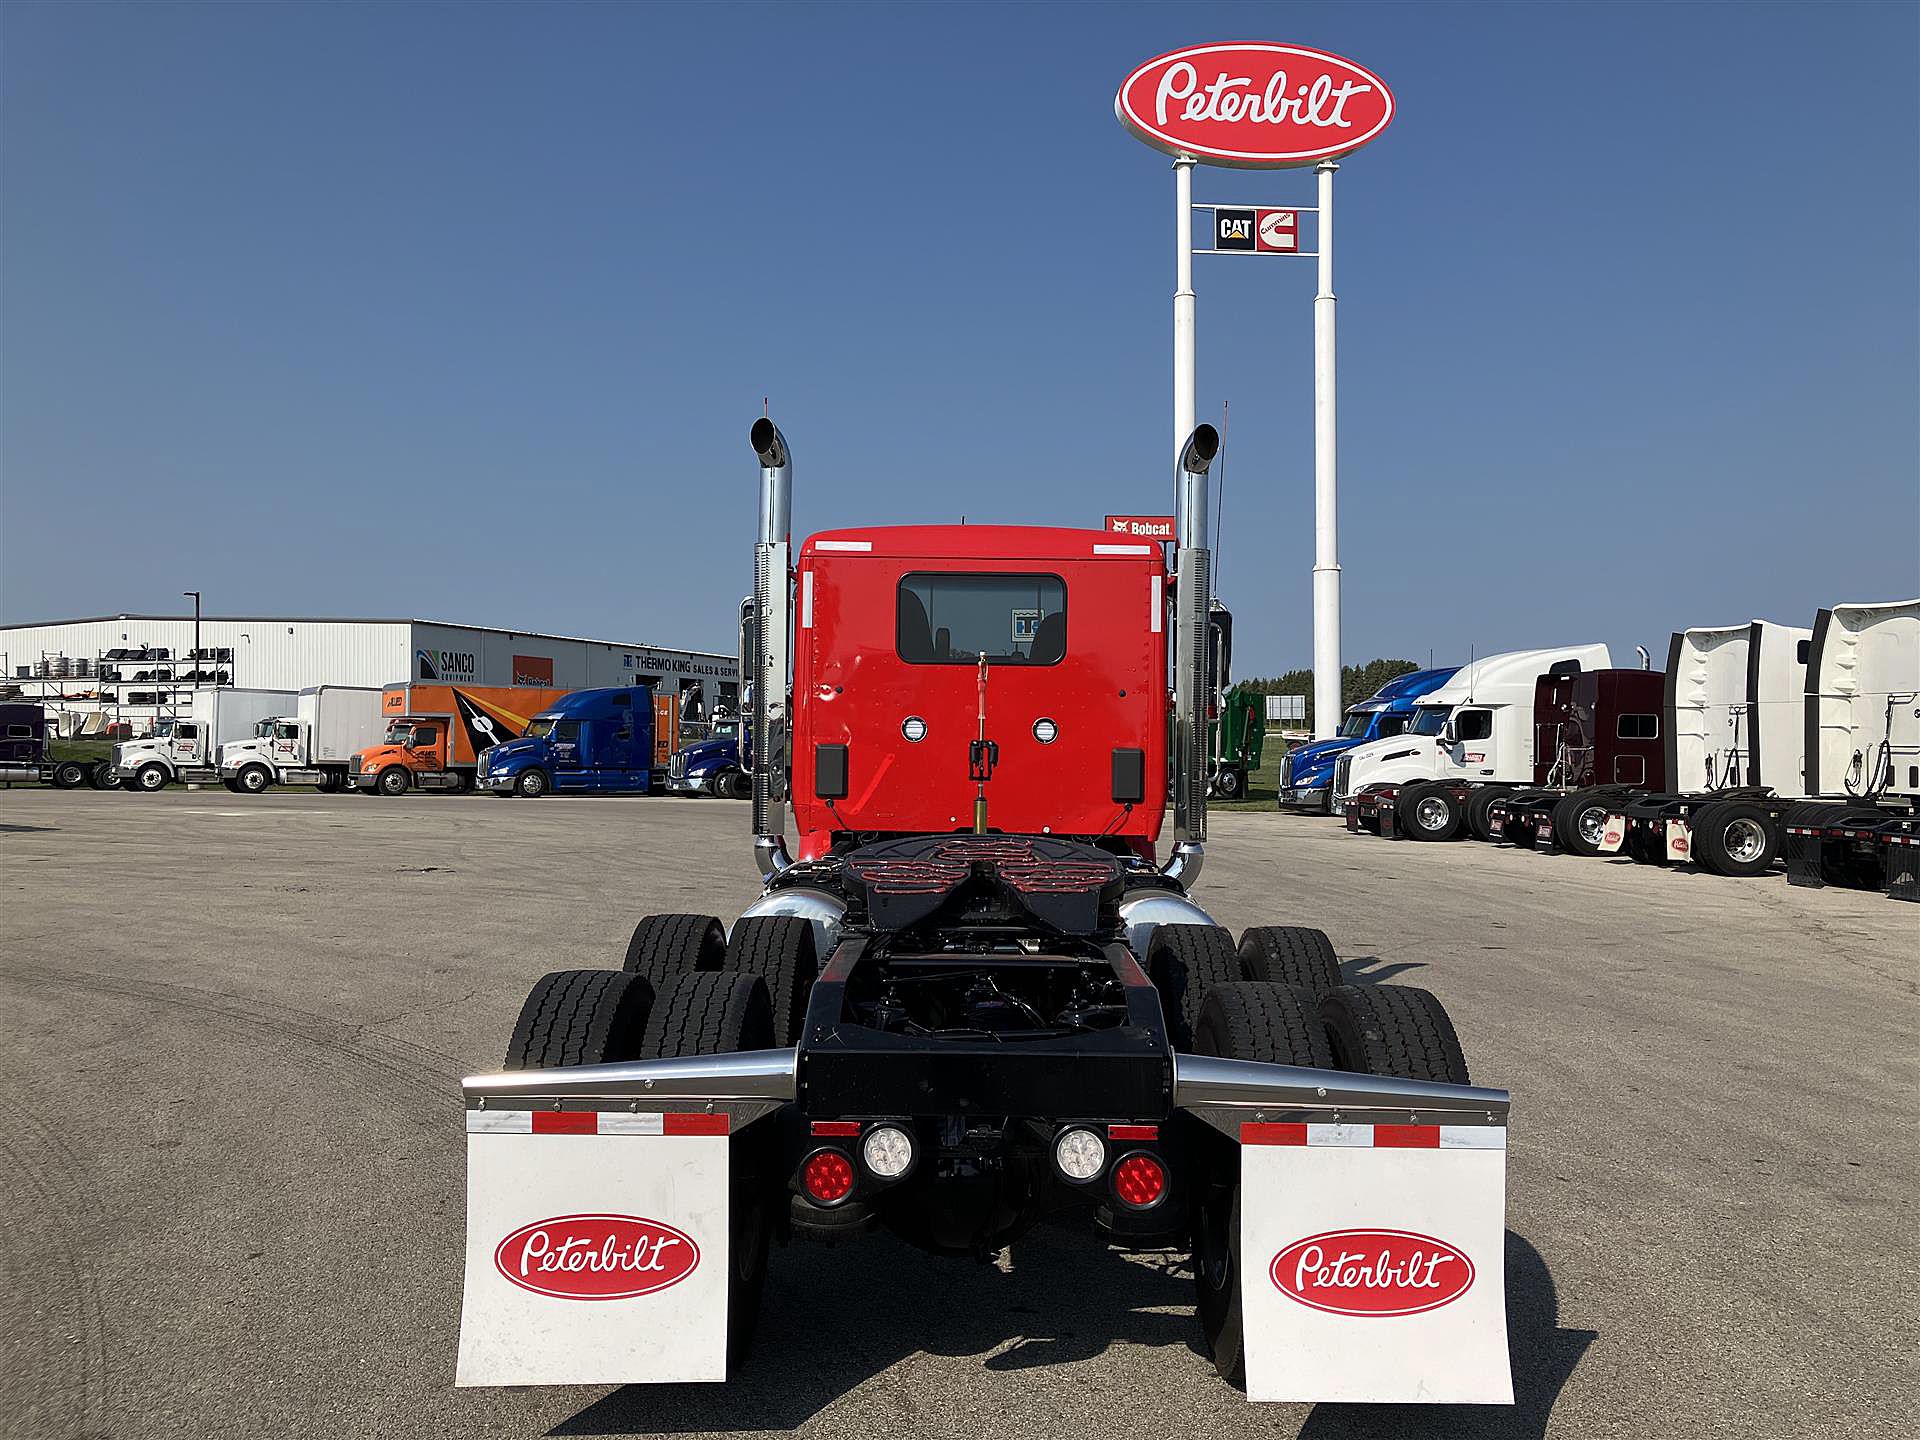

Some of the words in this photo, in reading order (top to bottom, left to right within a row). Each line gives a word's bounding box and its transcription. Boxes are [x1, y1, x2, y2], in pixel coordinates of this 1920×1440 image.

[1156, 61, 1372, 128] Peterbilt
[1220, 218, 1252, 240] CAT
[1260, 213, 1291, 235] Cummins
[1131, 521, 1170, 536] Bobcat
[441, 651, 475, 674] SANCO
[635, 655, 670, 671] THERMO
[672, 659, 691, 674] KING
[693, 664, 713, 676] SALES
[720, 666, 738, 677] SERVI
[441, 673, 475, 683] EQUIPMENT
[520, 1230, 680, 1277] Peterbilt
[1295, 1245, 1455, 1292] Peterbilt
